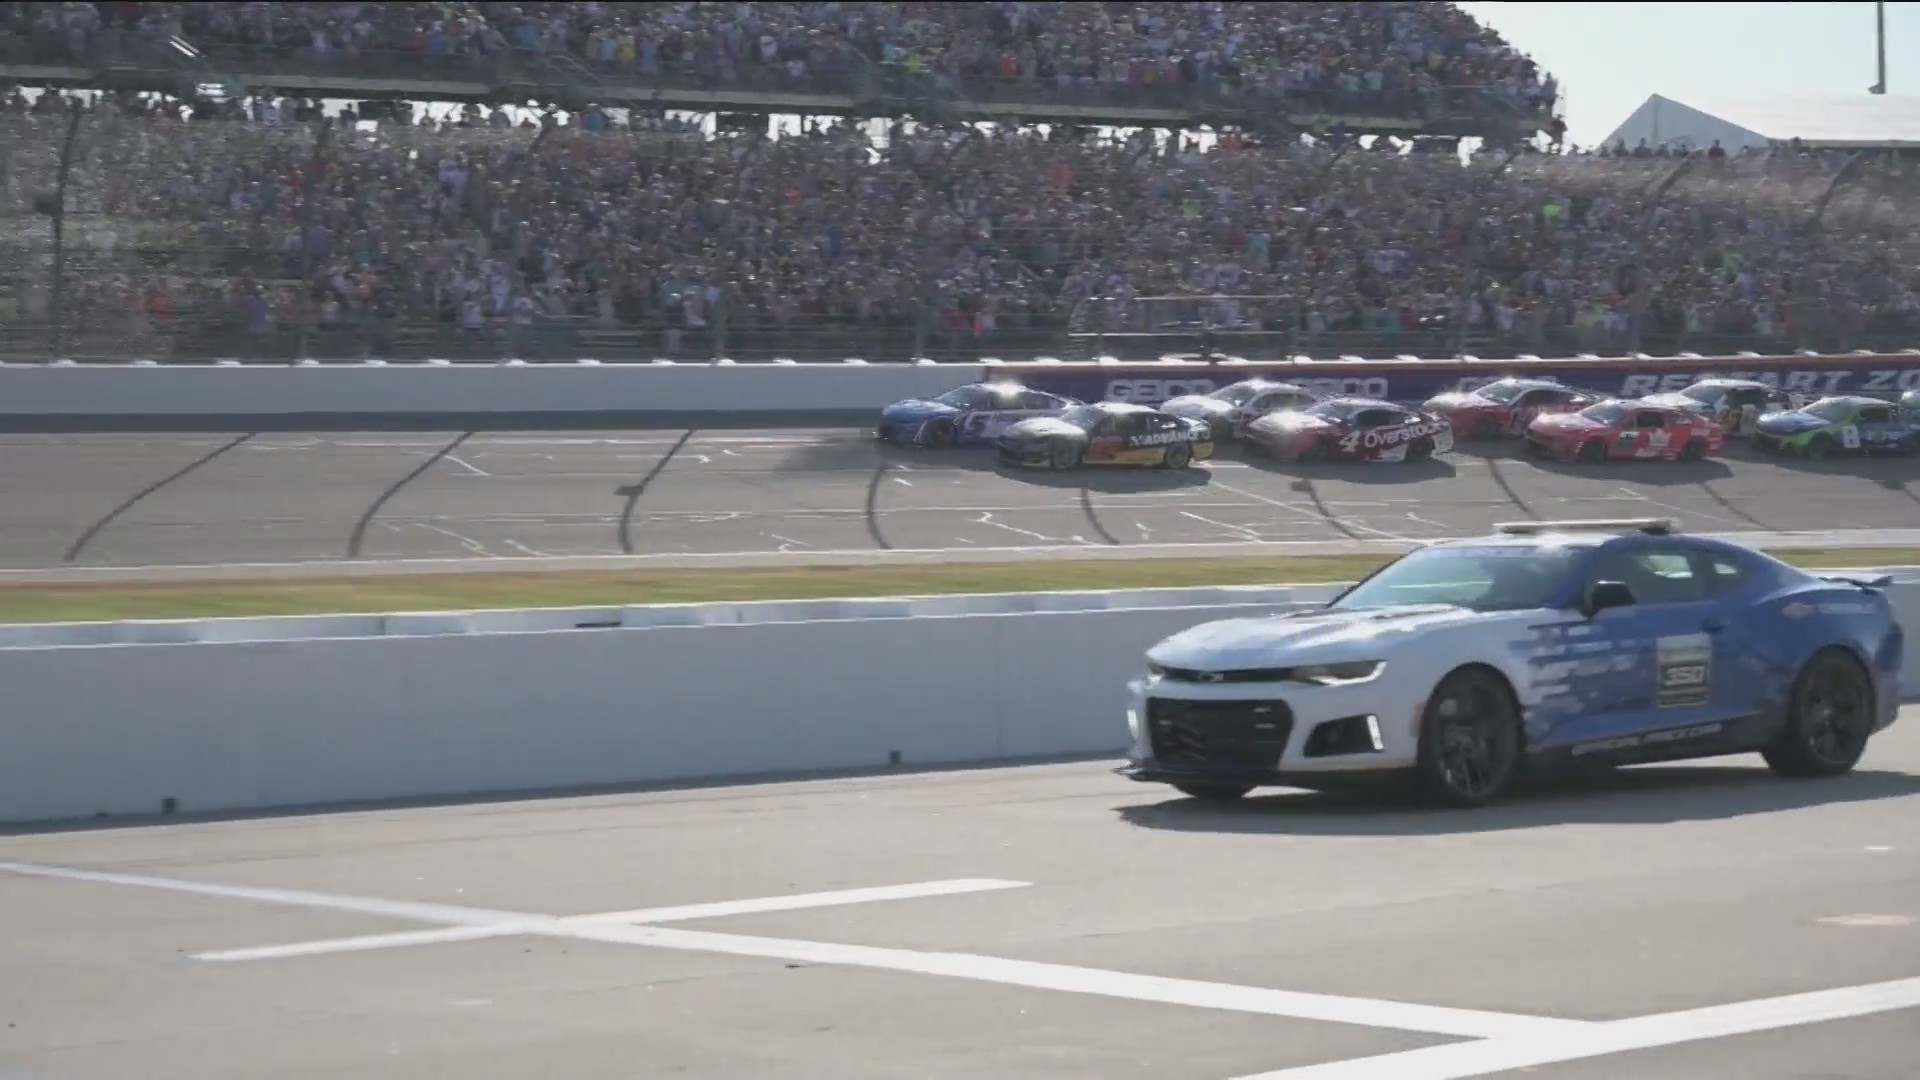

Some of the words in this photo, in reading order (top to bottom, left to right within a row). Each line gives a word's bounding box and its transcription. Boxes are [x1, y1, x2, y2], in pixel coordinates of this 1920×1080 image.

[1621, 371, 1852, 397] REART
[1337, 429, 1361, 452] 4
[1841, 424, 1861, 449] 8
[1664, 666, 1705, 687] 350
